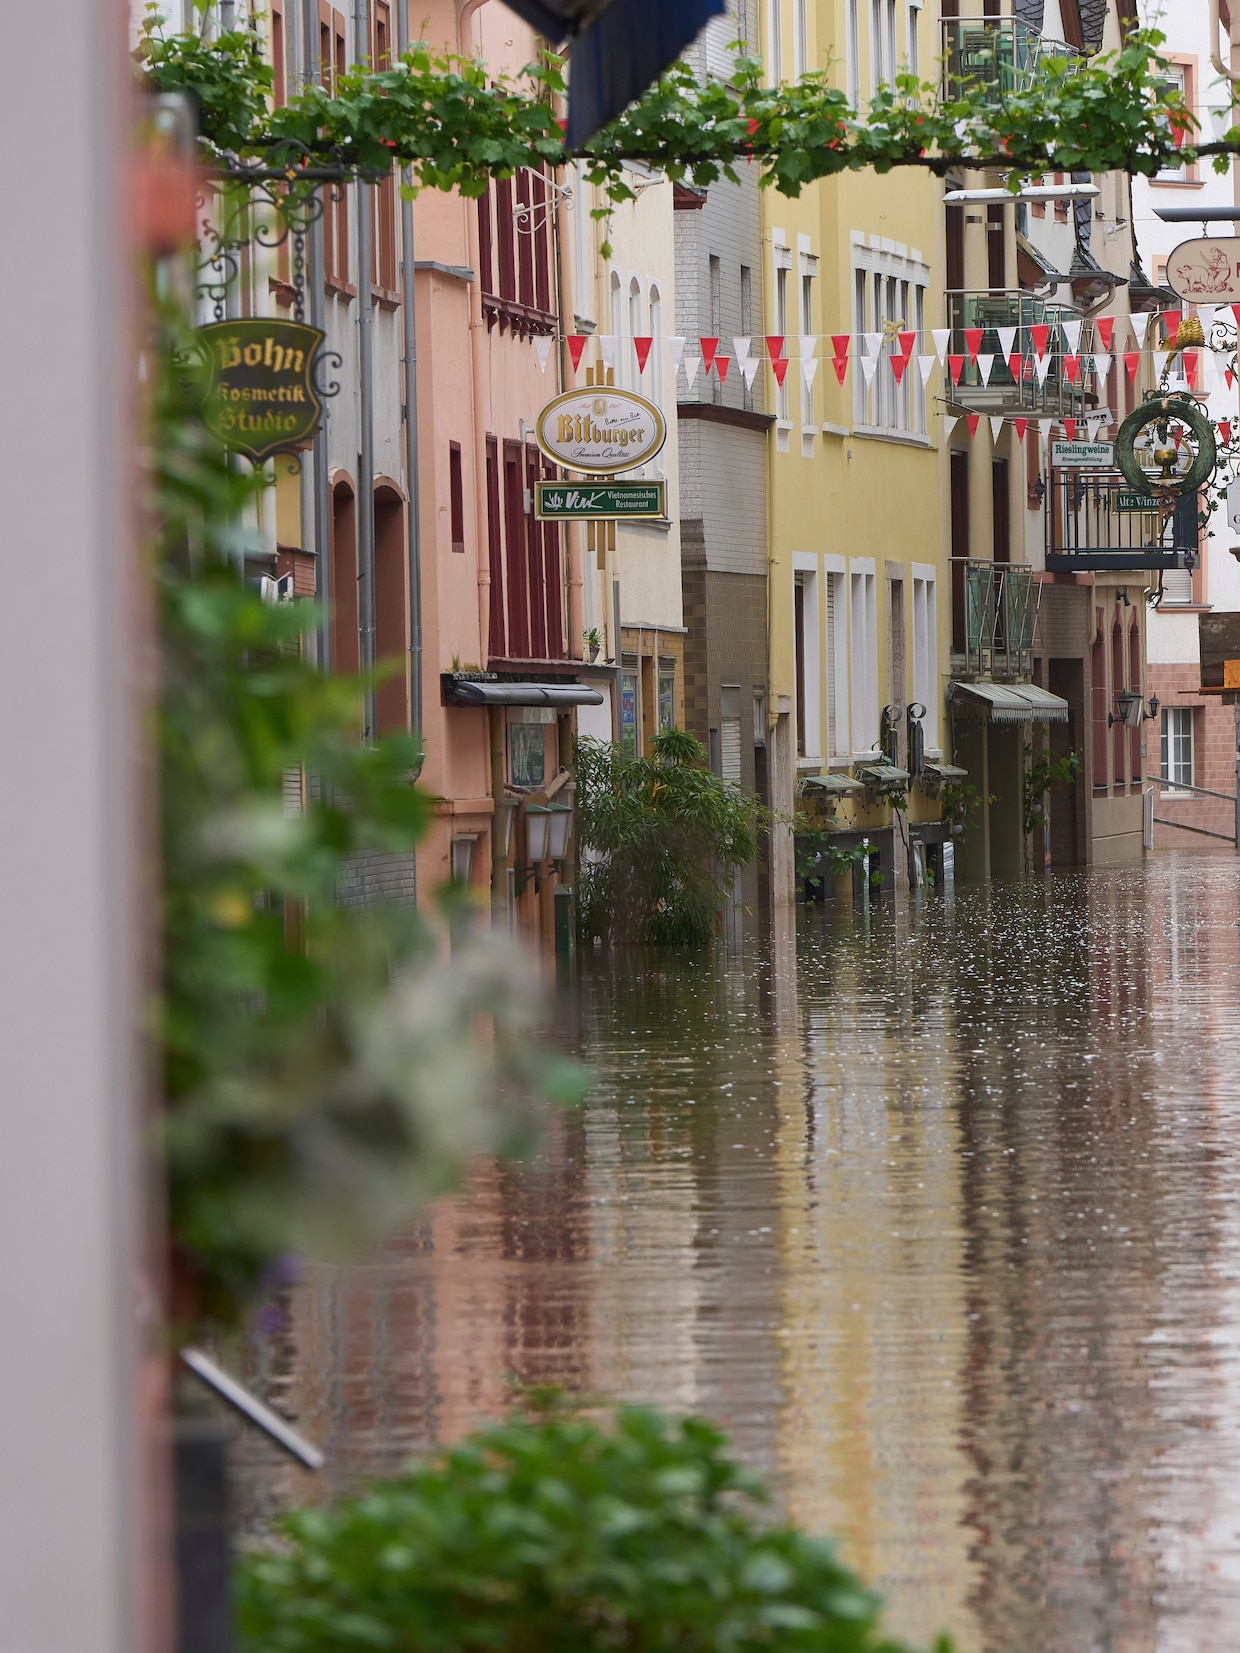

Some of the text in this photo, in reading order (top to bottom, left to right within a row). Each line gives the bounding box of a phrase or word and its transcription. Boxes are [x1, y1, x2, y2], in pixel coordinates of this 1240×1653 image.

[216, 336, 305, 373] Bohn
[217, 381, 306, 403] Kosmetik
[220, 407, 297, 432] Studio
[556, 413, 645, 447] Bitburger
[1055, 444, 1110, 457] Rieslingweine
[607, 490, 657, 499] Vietnamesisches
[615, 499, 649, 508] Restaurant
